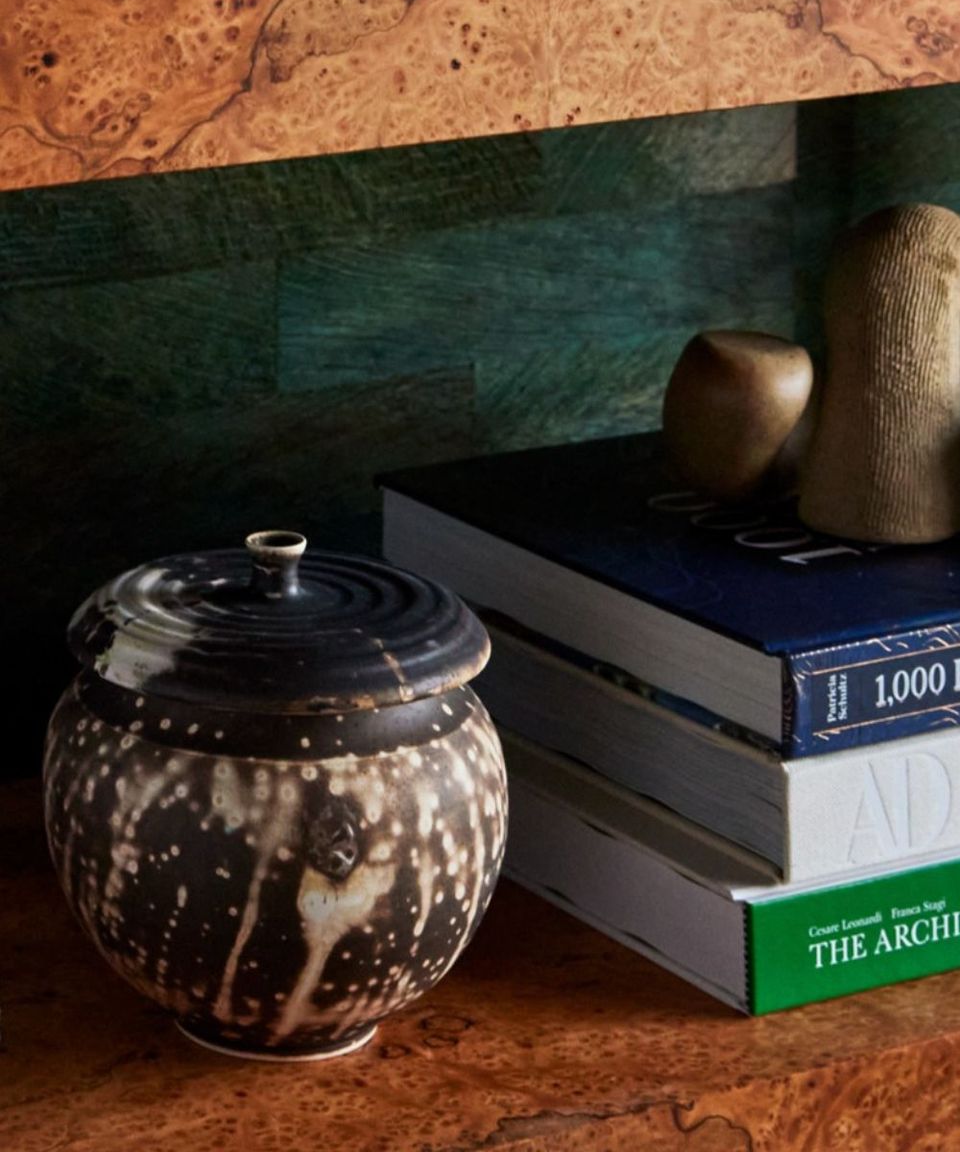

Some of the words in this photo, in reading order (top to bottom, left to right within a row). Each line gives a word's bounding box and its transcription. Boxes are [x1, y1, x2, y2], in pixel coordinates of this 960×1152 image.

[827, 674, 837, 724] Patricia
[838, 672, 848, 721] Schultz
[874, 663, 946, 709] 1,000
[847, 751, 952, 864] AD
[808, 919, 840, 938] Cesare
[841, 911, 882, 931] Leonardi
[891, 901, 921, 919] Franca
[922, 897, 946, 915] Stagi
[809, 933, 868, 969] THE
